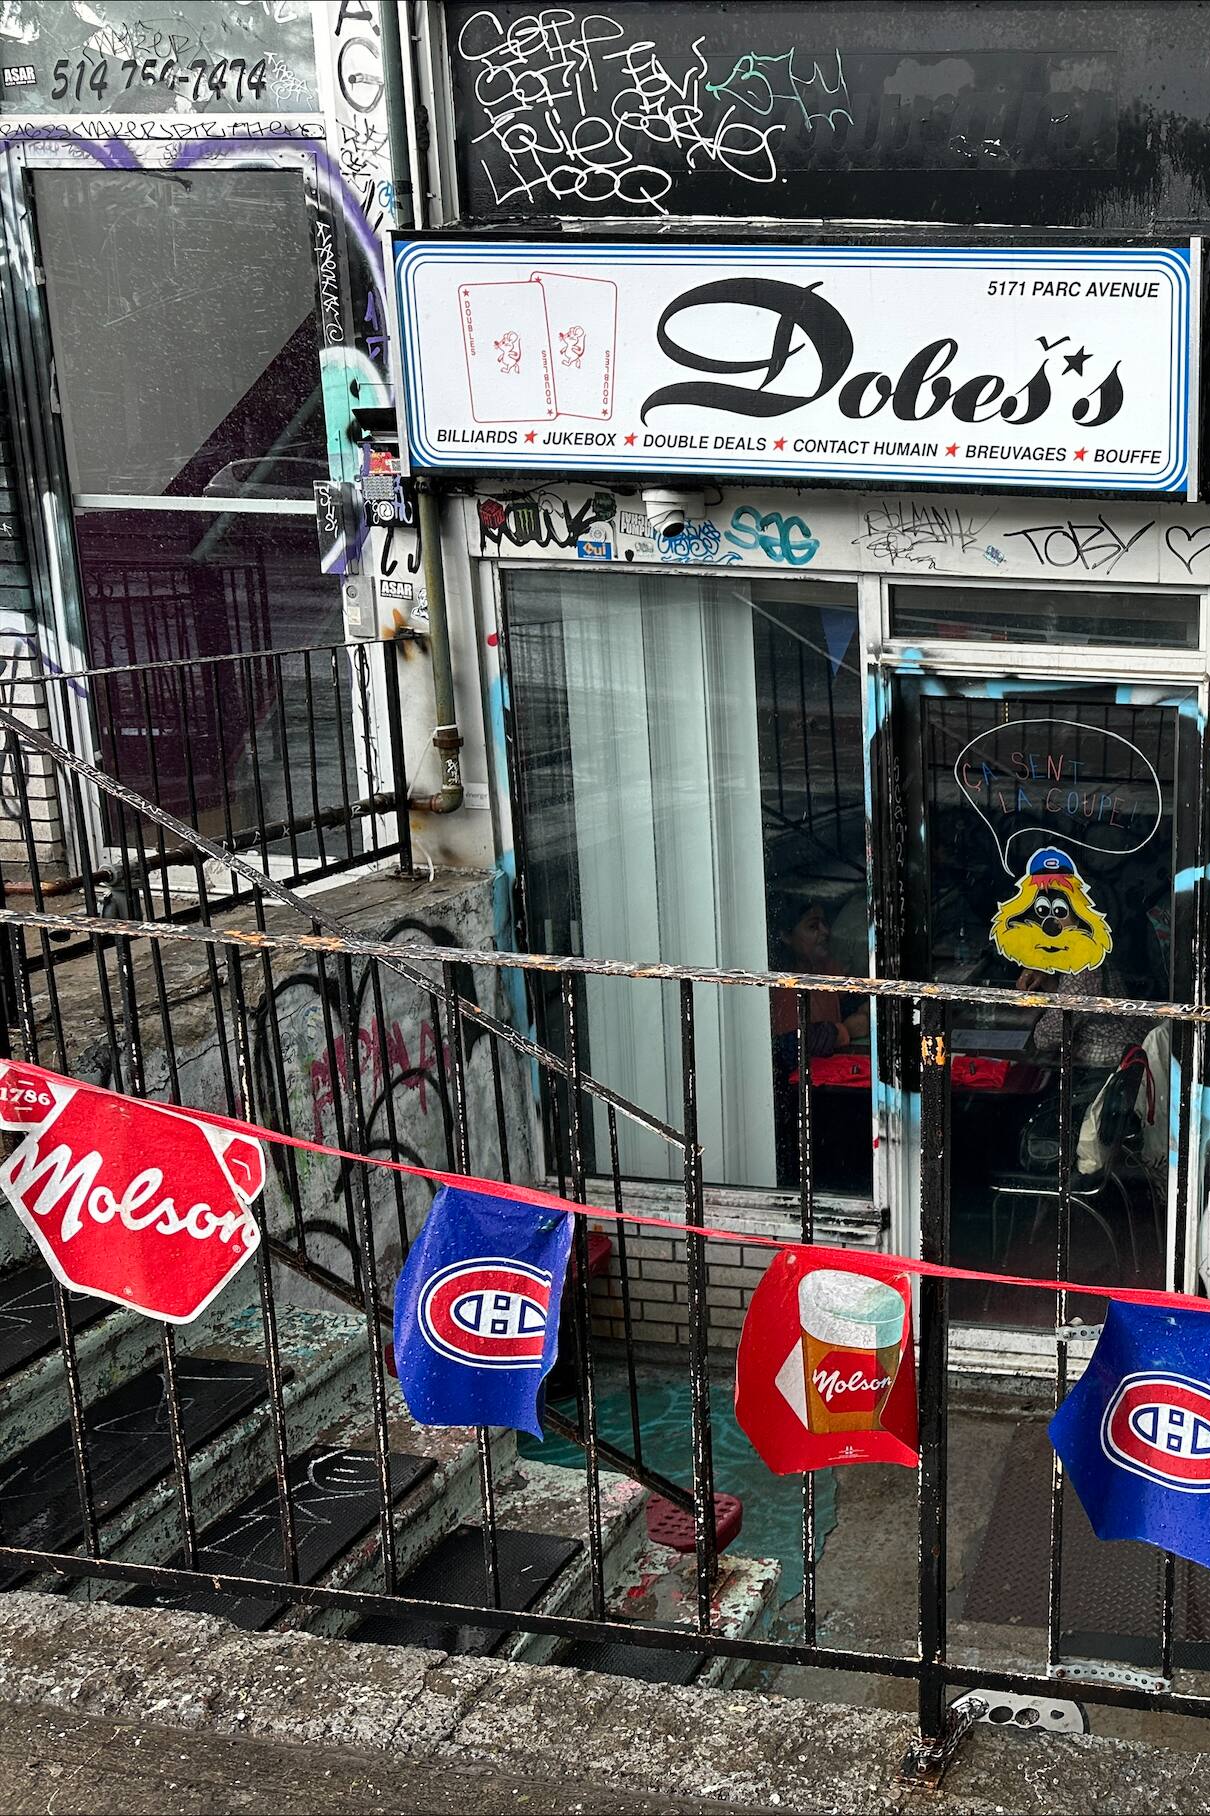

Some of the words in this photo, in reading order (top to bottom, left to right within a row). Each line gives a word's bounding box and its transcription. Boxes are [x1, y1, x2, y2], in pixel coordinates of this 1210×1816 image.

[4, 66, 35, 82] ASAR
[51, 60, 108, 101] 514
[988, 281, 1026, 297] 5171
[1032, 281, 1081, 297] PARC
[1086, 282, 1160, 298] AVENUE
[463, 300, 477, 356] DOUBLES
[540, 350, 553, 406] DOUBLES
[602, 350, 611, 406] DOUBLES
[436, 429, 518, 445] BILLIARDS
[542, 431, 617, 447] JUKEBOX
[643, 434, 708, 449] DOUBLE
[714, 436, 767, 451] DEALS
[793, 438, 870, 455] CONTACT
[873, 441, 938, 457] HUMAIN
[965, 445, 1067, 462] BREUVAGES
[1094, 449, 1161, 465] BOUFFE
[1003, 514, 1155, 575] TOBY
[381, 580, 412, 596] ASAR
[1011, 751, 1086, 785] SENT
[1000, 791, 1033, 815] LA
[0, 1086, 51, 1106] 1786
[2, 1140, 260, 1249] Molson
[813, 1368, 892, 1402] Molson
